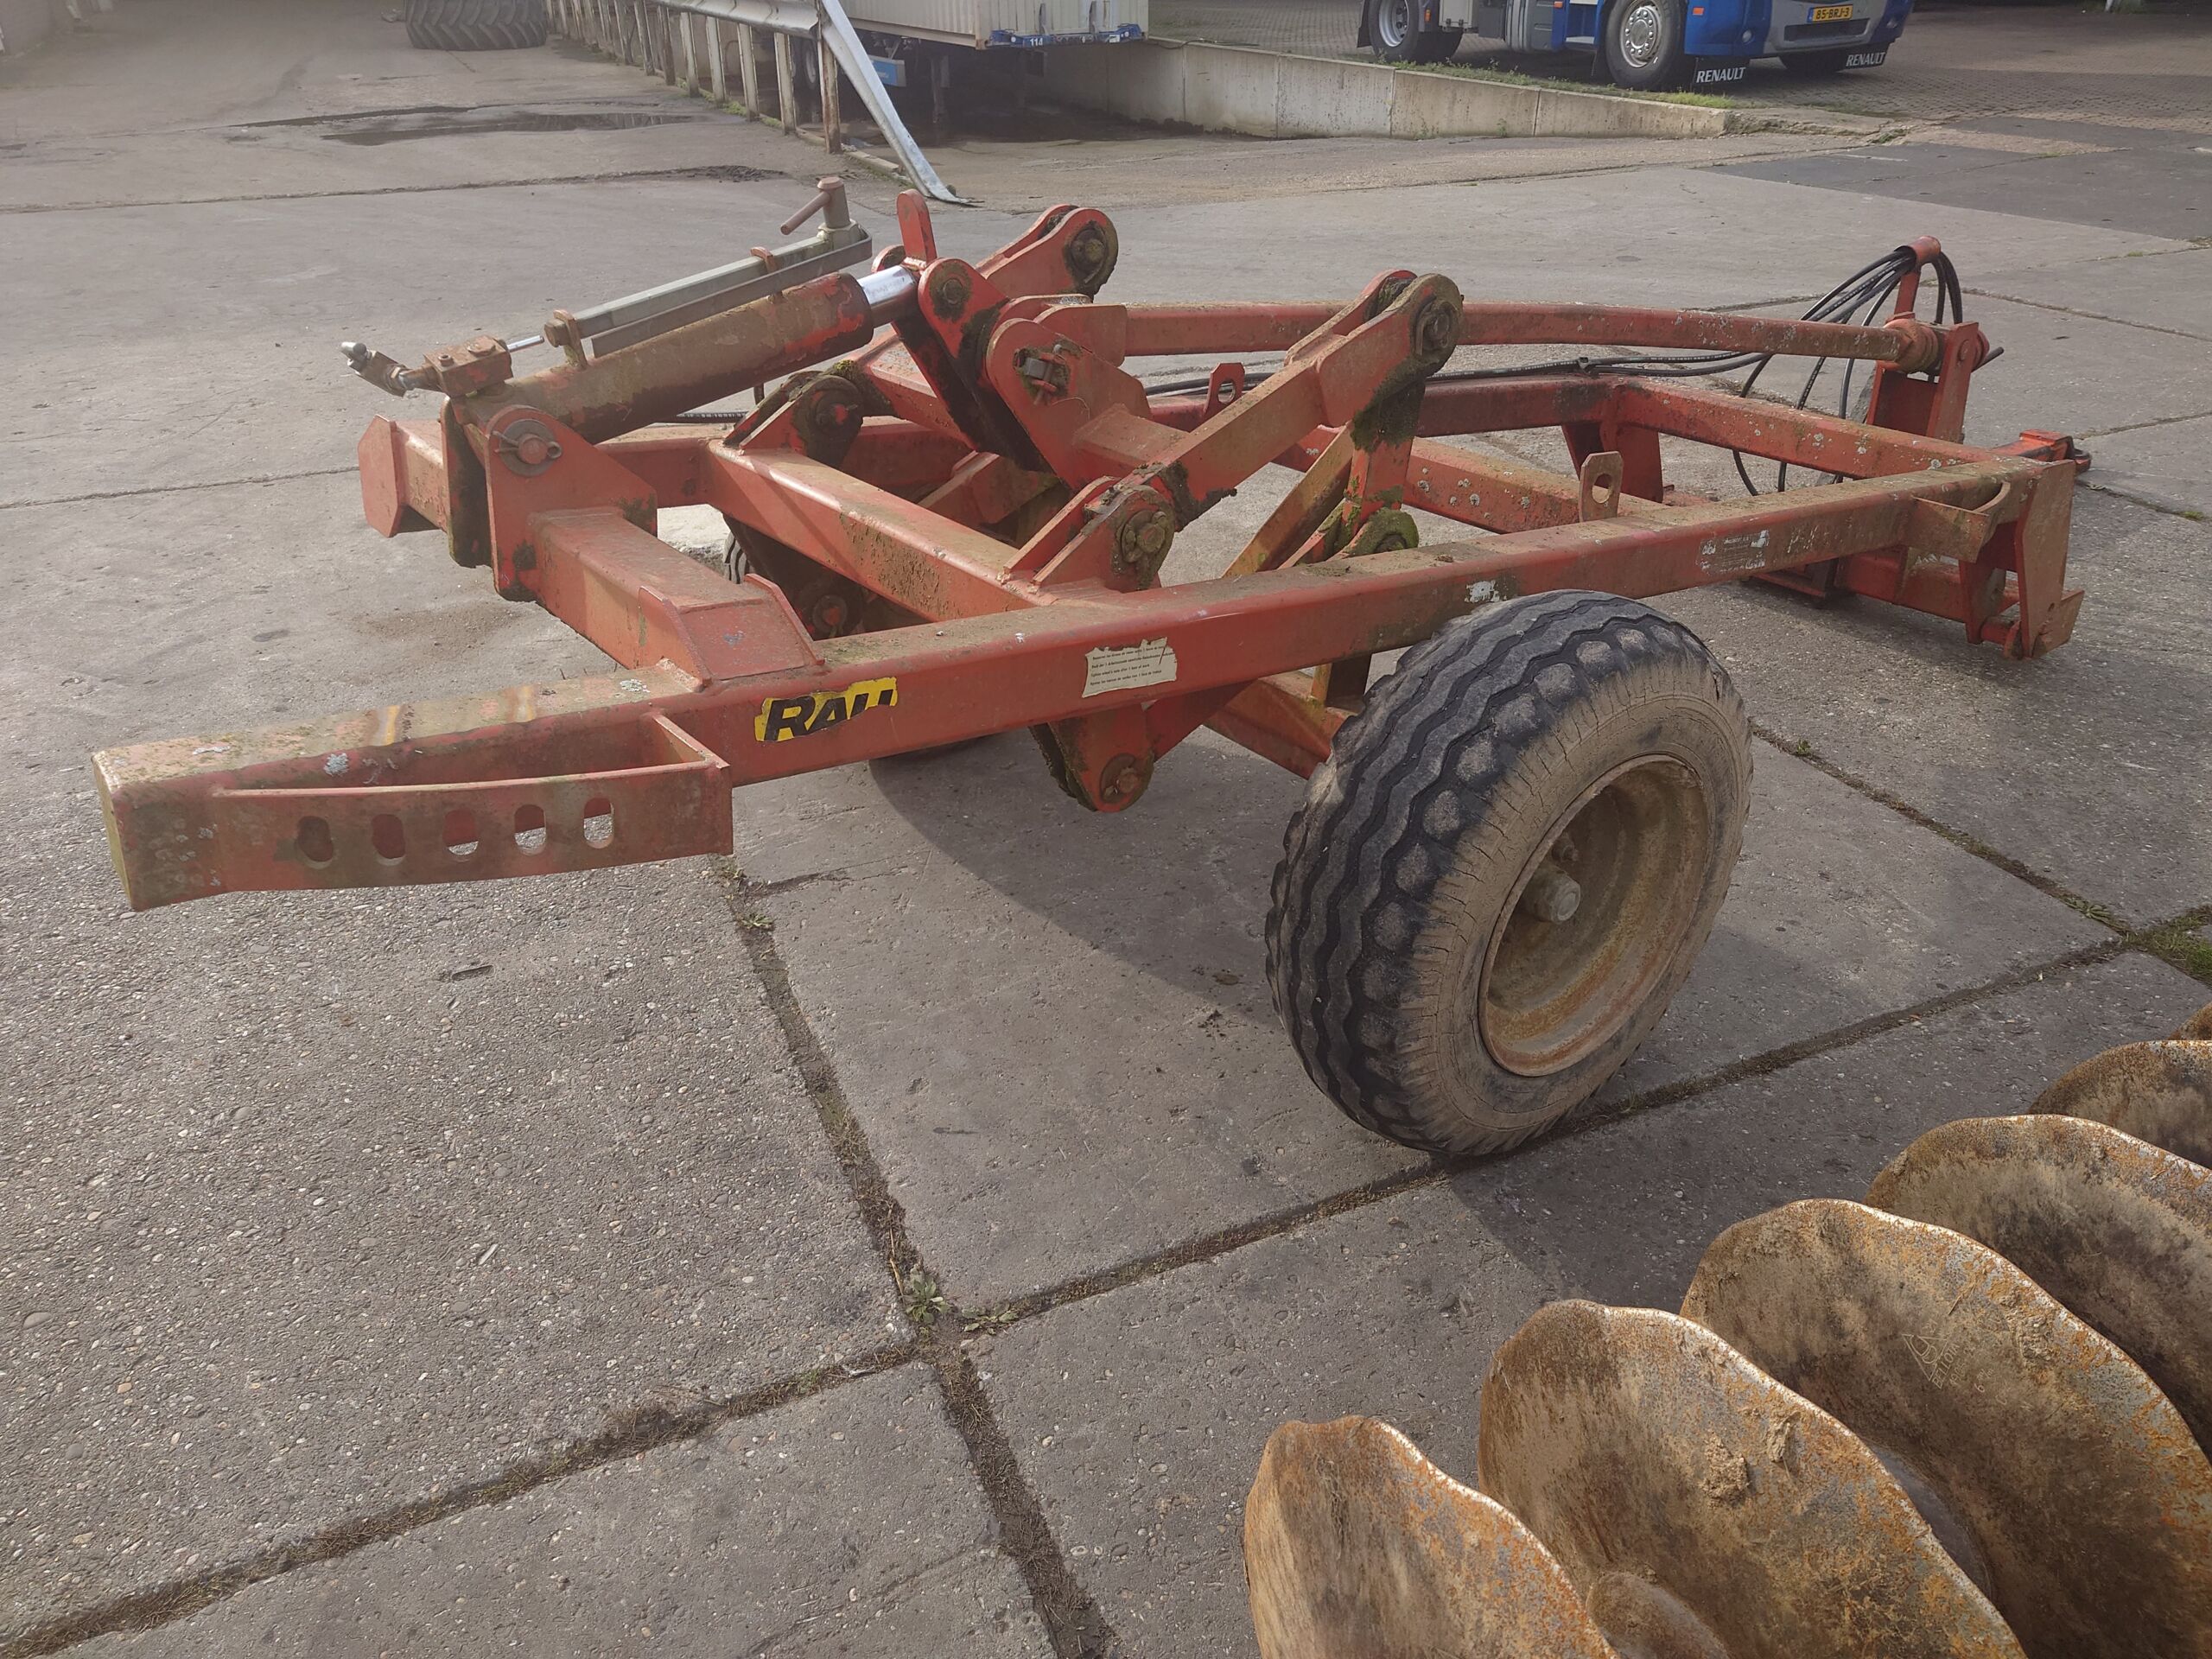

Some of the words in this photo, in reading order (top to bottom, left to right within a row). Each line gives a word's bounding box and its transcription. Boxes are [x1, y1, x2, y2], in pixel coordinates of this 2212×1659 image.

[1815, 7, 1850, 20] 85-BRJ-3
[1029, 37, 1043, 46] 114
[1845, 52, 1886, 67] RENAULT
[1695, 67, 1746, 84] RENAULT
[1932, 1343, 1961, 1389] BELLOTA
